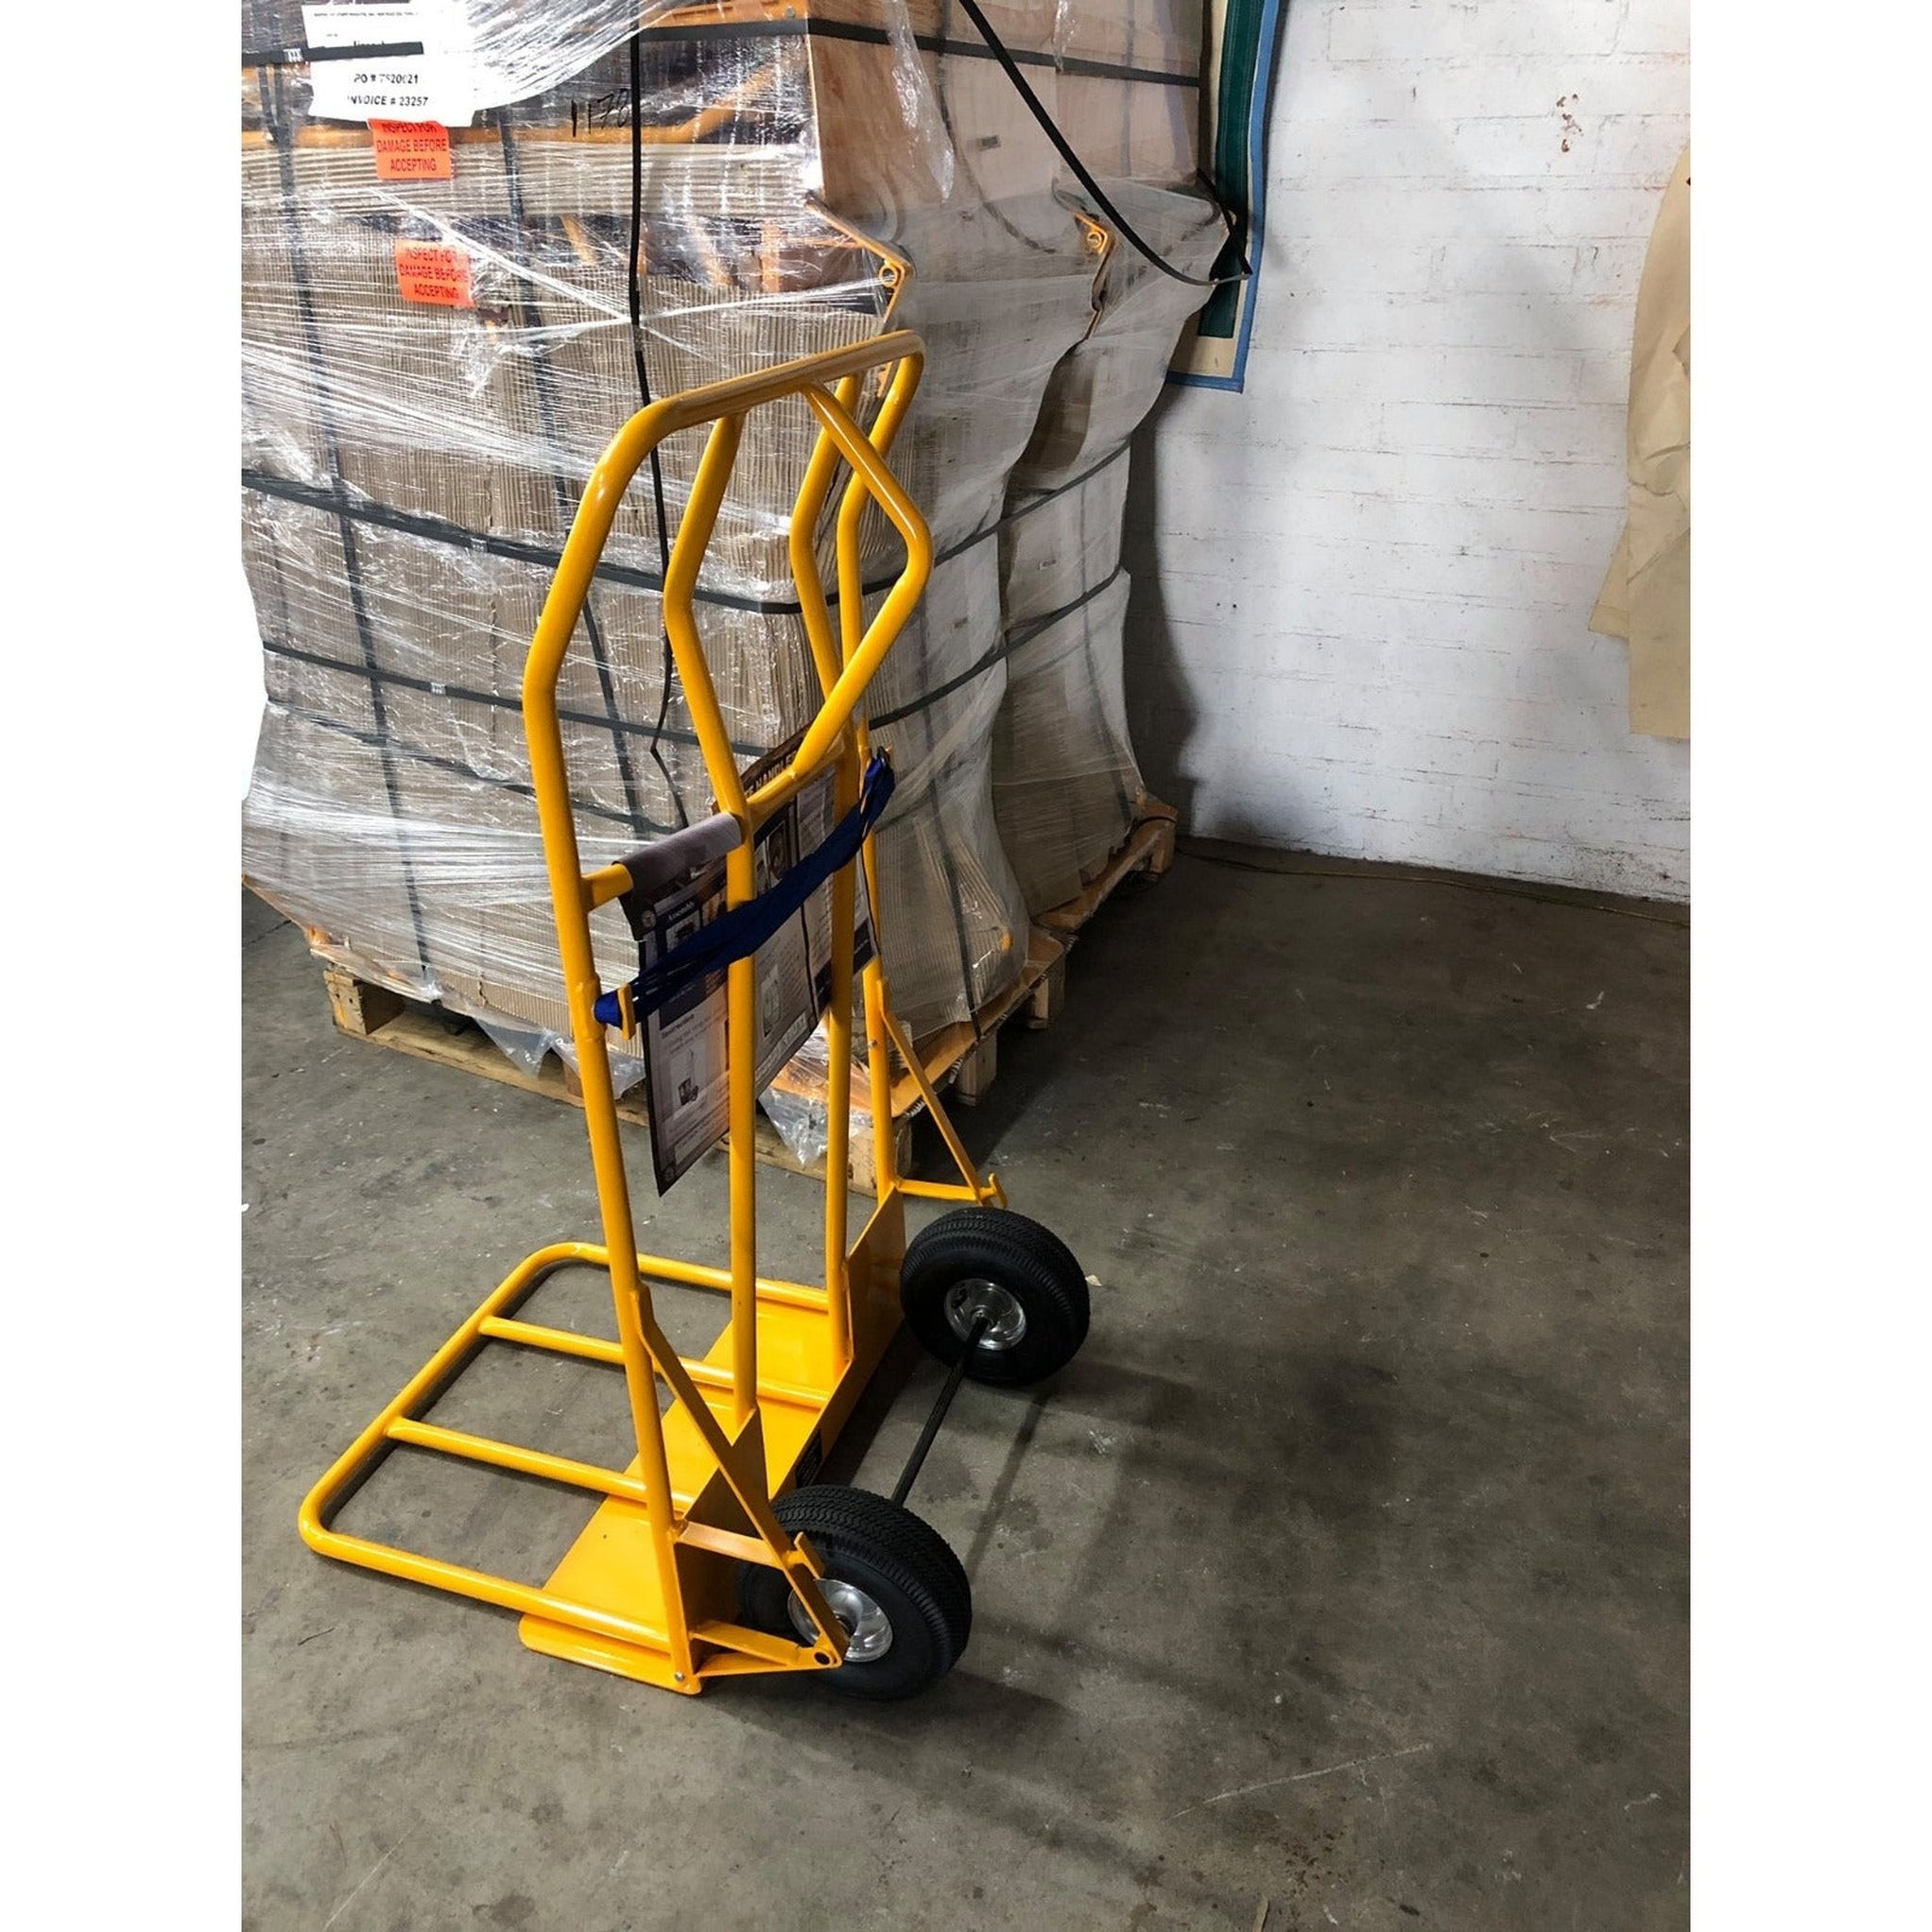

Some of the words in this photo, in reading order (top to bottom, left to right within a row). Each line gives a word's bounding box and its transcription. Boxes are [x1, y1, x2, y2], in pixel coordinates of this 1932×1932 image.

[399, 95, 429, 107] 23257
[376, 139, 411, 152] DAMAGE
[413, 138, 447, 152] BEFORE
[390, 157, 437, 171] ACCEPTING
[399, 264, 433, 280] DAMAGE
[414, 284, 459, 299] ACCEPTING
